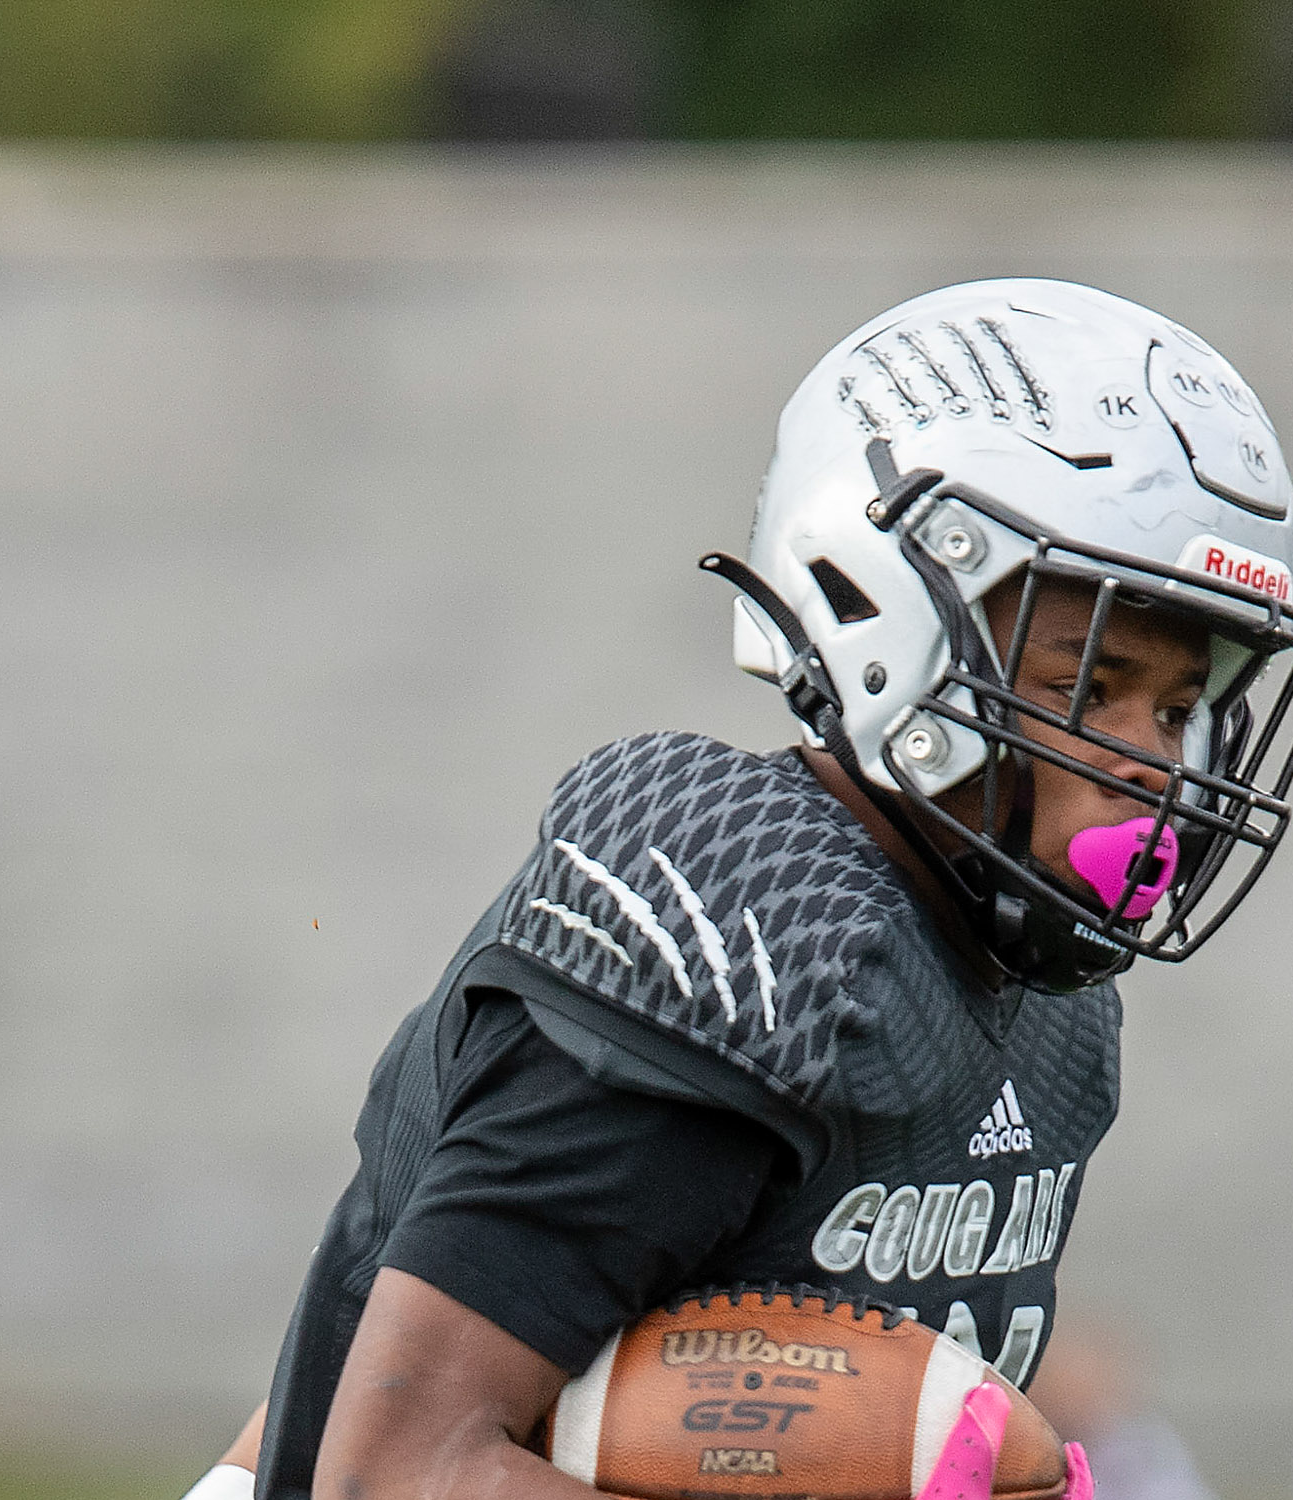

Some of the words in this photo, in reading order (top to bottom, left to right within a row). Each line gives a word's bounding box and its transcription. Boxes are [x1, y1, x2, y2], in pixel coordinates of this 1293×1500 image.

[1173, 371, 1211, 395] 1K
[1099, 395, 1138, 417] 1K
[1243, 443, 1268, 471] 1K
[1204, 547, 1289, 601] Riddell
[968, 1126, 1033, 1160] adidas
[662, 1328, 851, 1374] Wilson
[682, 1400, 816, 1434] GST
[700, 1449, 780, 1475] NCAA
